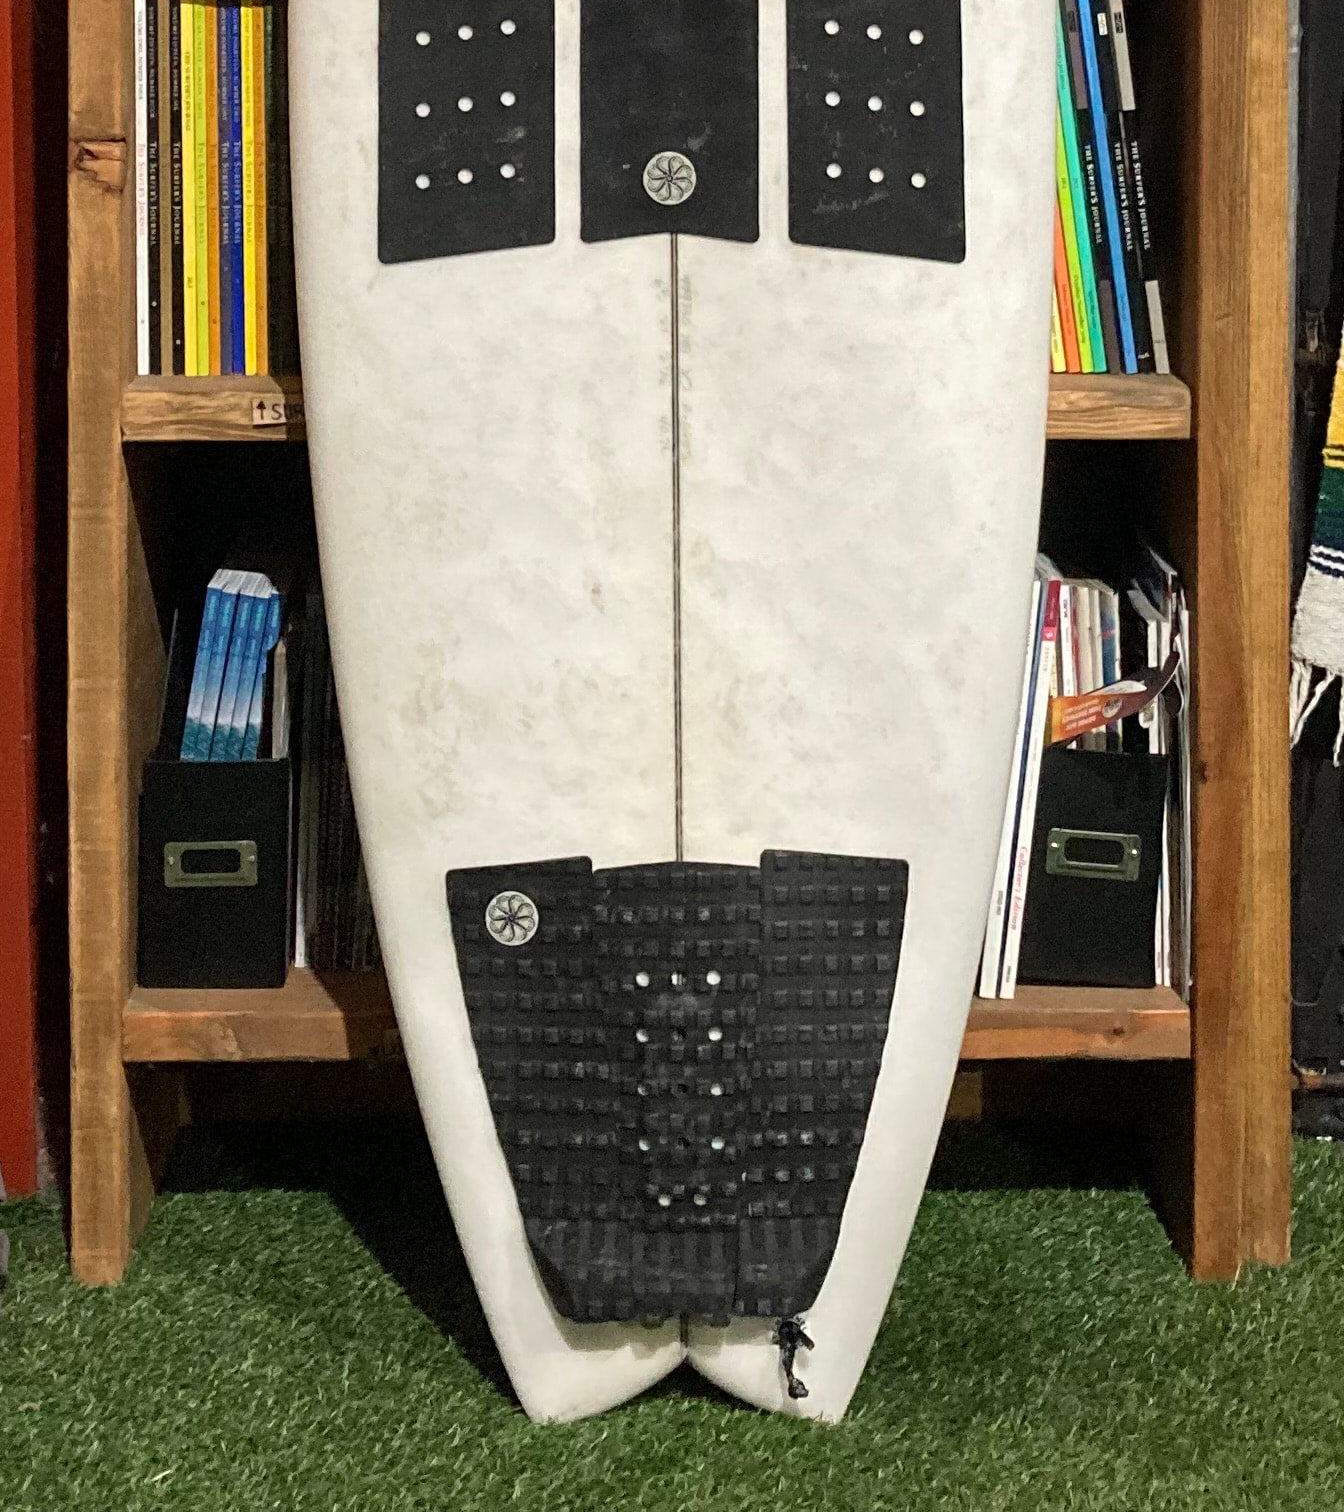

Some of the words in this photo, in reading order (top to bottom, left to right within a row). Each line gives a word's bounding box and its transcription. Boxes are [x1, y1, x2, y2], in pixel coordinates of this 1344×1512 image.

[149, 142, 157, 159] THE
[173, 142, 181, 159] THE
[222, 142, 230, 159] THE
[233, 141, 241, 159] THE
[1084, 145, 1092, 161] THE
[1131, 140, 1139, 160] THE
[1087, 164, 1099, 204] SURFER'S
[1116, 164, 1128, 207] SURFER'S
[1133, 162, 1146, 206] SURFER'S
[149, 206, 158, 245] JOURNAL
[172, 206, 181, 245] JOURNAL
[222, 206, 230, 244] JOURNAL
[234, 205, 242, 244] JOURNAL
[1091, 206, 1103, 244] JOURNAL
[1121, 210, 1133, 251] JOURNAL
[1138, 208, 1150, 250] JOURNAL
